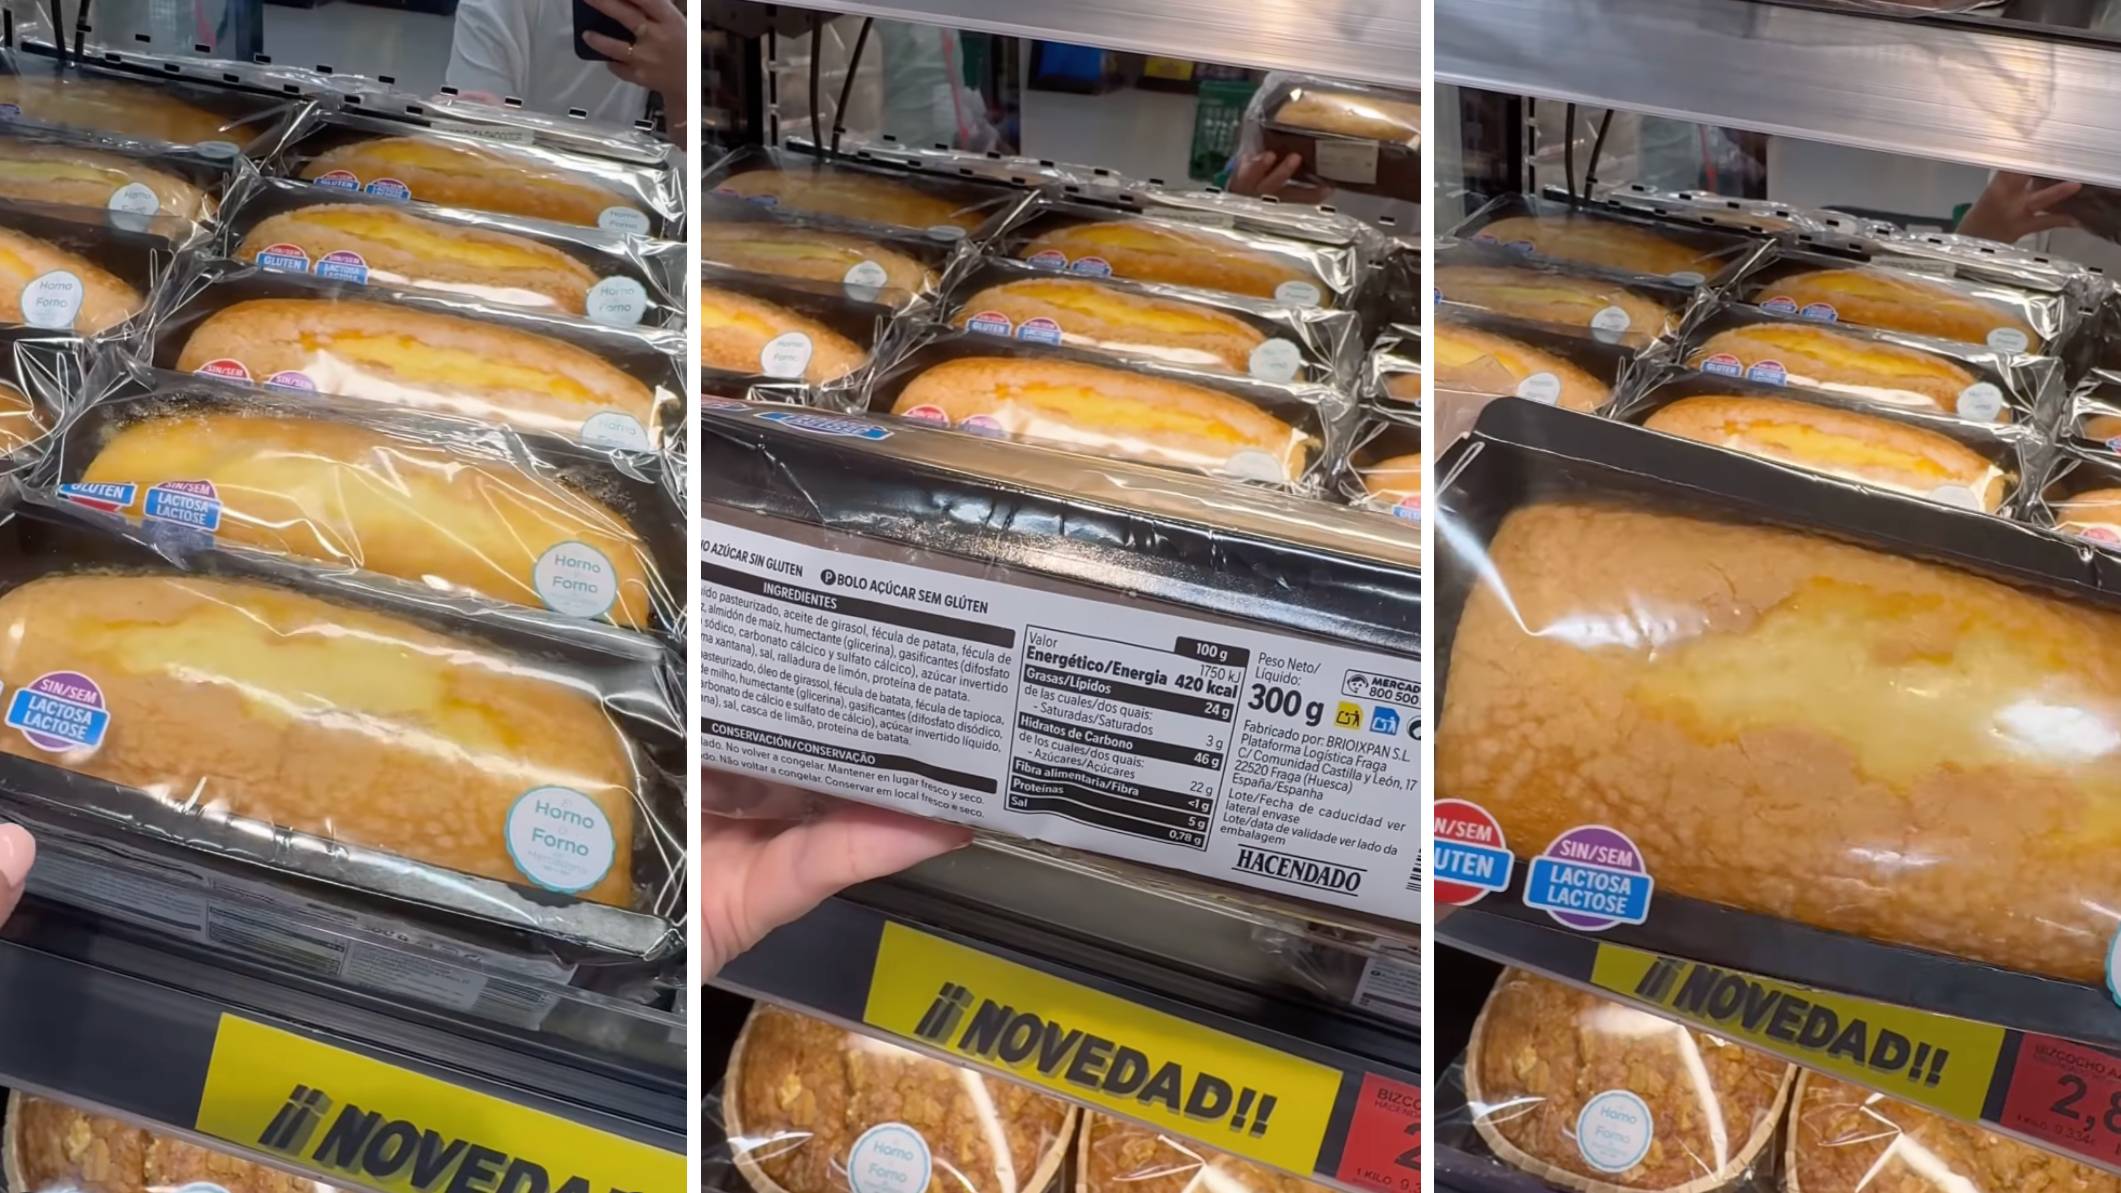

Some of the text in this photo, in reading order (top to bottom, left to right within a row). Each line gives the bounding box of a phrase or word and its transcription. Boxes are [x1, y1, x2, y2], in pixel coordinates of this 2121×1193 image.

[264, 256, 302, 269] GLUTEN
[156, 504, 207, 525] LACTOSE
[158, 492, 209, 513] LACTOSA
[554, 554, 601, 574] Horno
[710, 541, 749, 563] AZÚCAR
[749, 552, 765, 567] SIN
[766, 556, 803, 577] GLUTEN
[552, 575, 598, 594] Forno
[763, 582, 838, 610] INGREDIENTES
[837, 574, 868, 590] BOLO
[869, 579, 916, 600] AÇÚCAR
[918, 589, 942, 605] SEM
[944, 594, 989, 614] GLÚTEN
[708, 604, 1010, 679] almidón de maíz, humectante (glicerina), gasificantes (difosfato
[720, 592, 1012, 665] pasteurizado, aceite de girasol, fécula de patata, fécula de
[1029, 631, 1242, 684] Valor 1750 kJ
[1196, 642, 1228, 661] 100 g
[1258, 652, 1321, 674] Peso Neto/
[1026, 645, 1238, 699] Energético/Energia 420 kcal
[1255, 667, 1301, 687] Líquido:
[40, 679, 97, 704] SIN/SEM
[1024, 685, 1153, 722] de las cuales/dos quais:
[1026, 667, 1231, 721] Grasas/Lípidos 24 g
[1248, 683, 1324, 727] 300 g
[1369, 687, 1419, 705] 800 500
[23, 711, 88, 740] LACTOSE
[28, 695, 93, 725] LACTOSA
[1040, 702, 1154, 736] Saturadas/Saturados
[711, 723, 876, 765] CONSERVACIÓN/CONSERVAÇÃO
[1019, 731, 1145, 769] de los cuales/dos quais:
[1020, 715, 1220, 769] Hidratos de Carbono 46 g
[1205, 735, 1224, 751] 3 g
[1241, 733, 1387, 773] Plataforma Logística Fraga
[1244, 720, 1300, 741] Fabricado
[1302, 733, 1325, 747] por:
[1326, 737, 1391, 758] BRIOIXPAN
[1034, 748, 1213, 797] Azúcares/Açúcares 22 g
[1234, 760, 1353, 793] 22520 Fraga (Huesca)
[1238, 747, 1418, 791] C/ Comunidad Castilla y León, 17
[1015, 760, 1042, 776] Fibra
[1044, 766, 1139, 797] alimentaria/Fibra
[1202, 802, 1210, 813] g
[1232, 772, 1323, 800] España/Espanha
[535, 800, 595, 829] Horno
[1012, 778, 1206, 830] Proteínas 5 g
[1225, 800, 1300, 824] lateral envase
[1228, 788, 1406, 832] Lote/Fecha de caducidad ver
[1010, 796, 1028, 808] Sal
[1194, 837, 1202, 846] g
[1220, 824, 1286, 846] embalagem
[1223, 811, 1398, 856] Lote/data de validade ver lado da
[531, 827, 589, 857] Forno
[1559, 839, 1633, 868] SIN/SEM
[1237, 849, 1361, 892] HACENDADO
[1551, 865, 1632, 895] LACTOSA
[1547, 885, 1629, 914] LACTOSE
[873, 1140, 914, 1161] Horno
[868, 1163, 907, 1183] Forno
